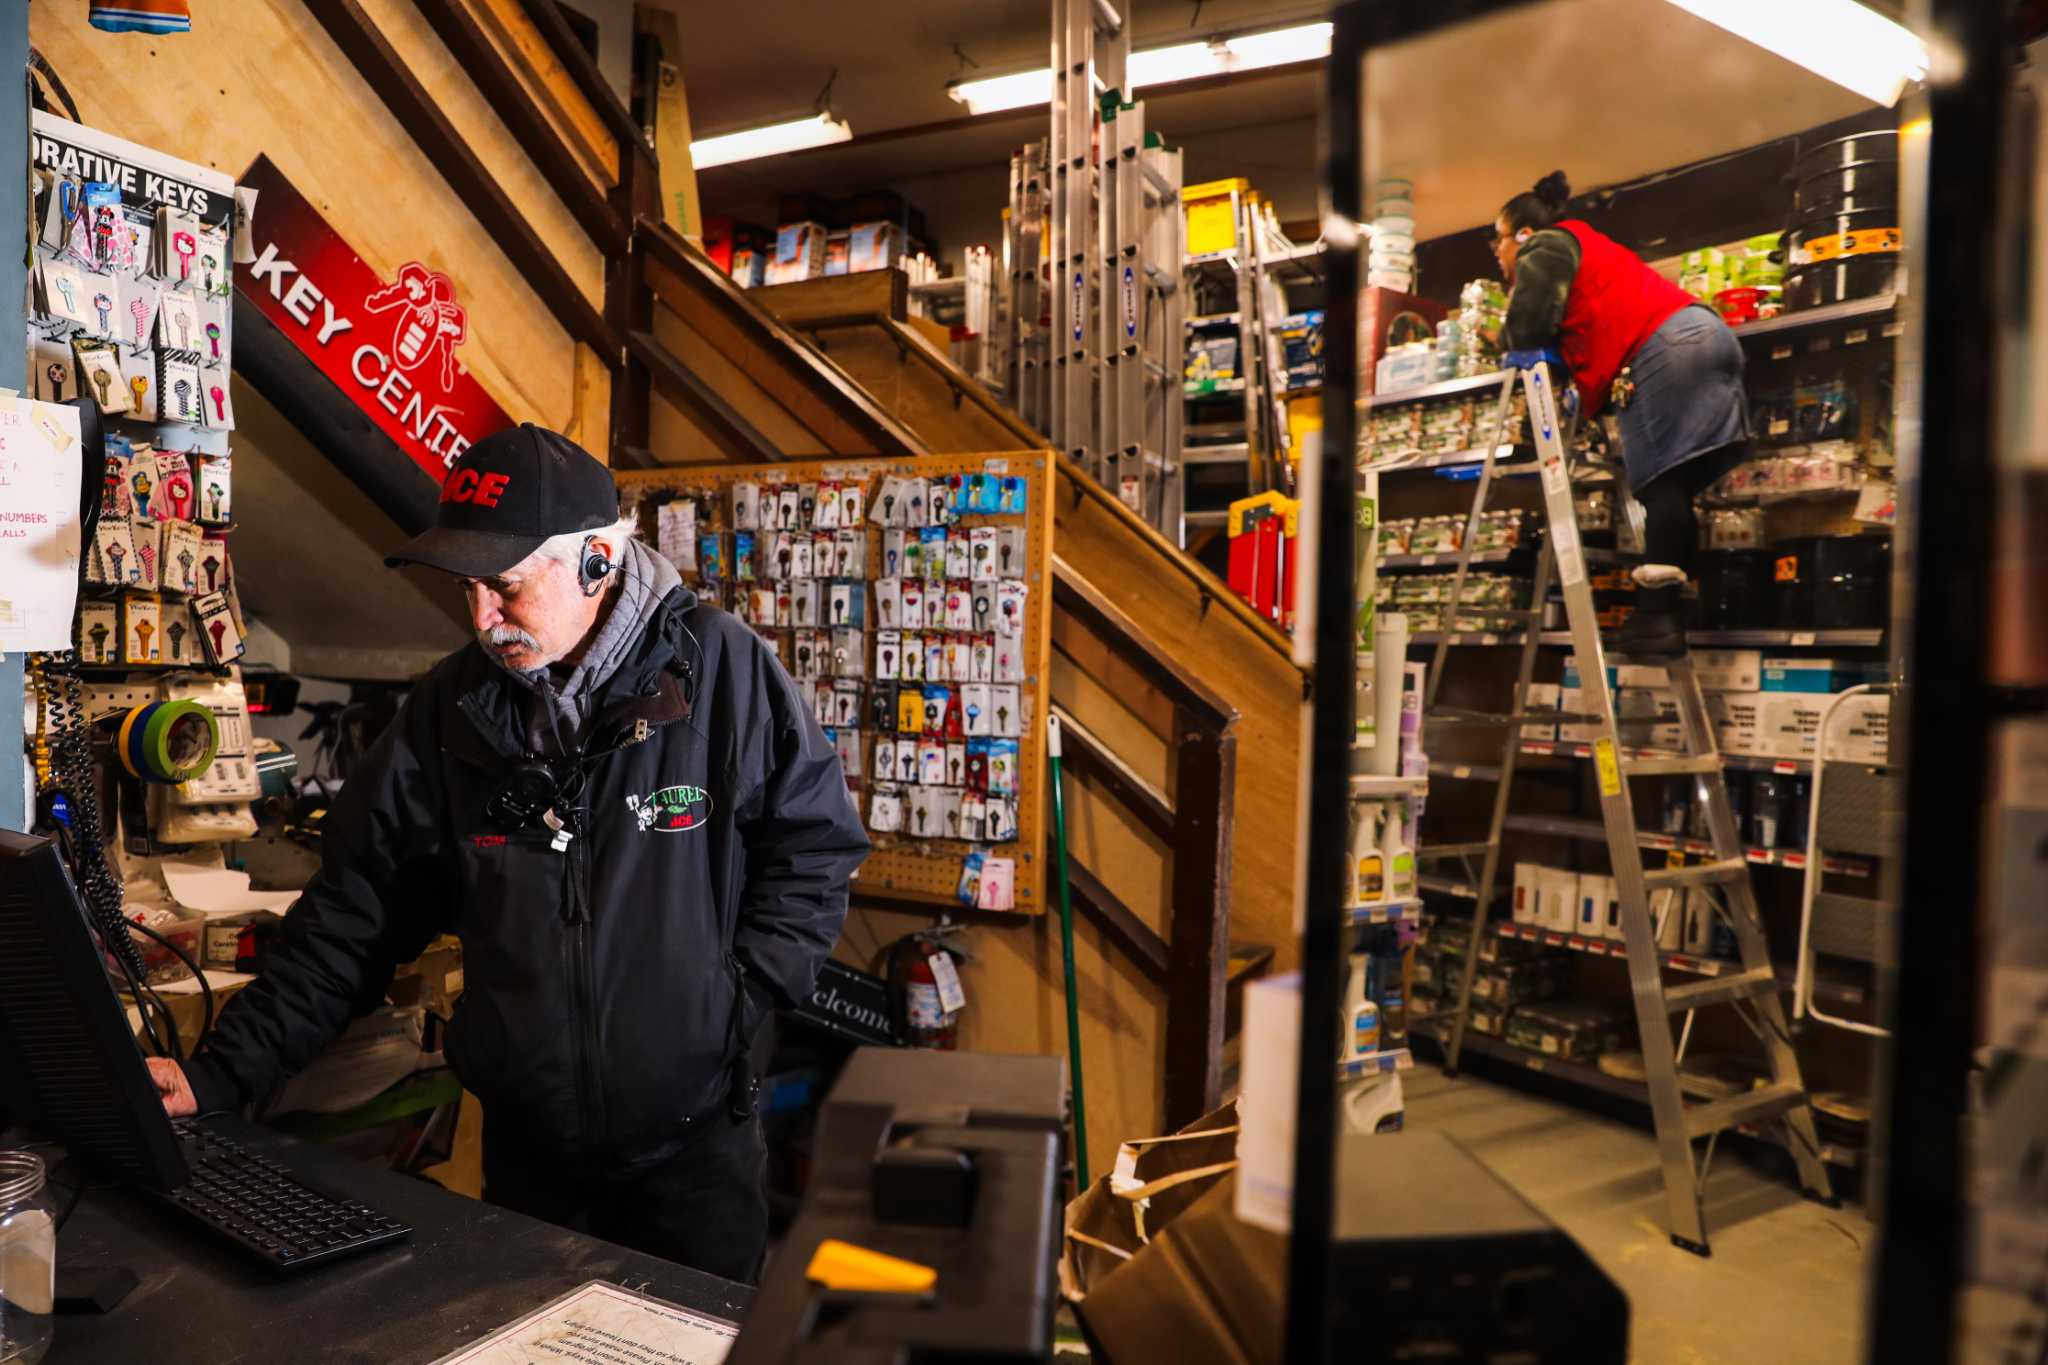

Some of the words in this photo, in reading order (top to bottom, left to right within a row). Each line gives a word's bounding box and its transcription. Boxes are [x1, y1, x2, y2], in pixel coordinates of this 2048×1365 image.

[145, 172, 209, 216] KEYS
[250, 243, 353, 346] KEY
[351, 344, 471, 469] CENTE
[0, 512, 48, 524] NUMBERS
[651, 786, 704, 806] LAUREL
[811, 986, 892, 1034] elcom
[580, 1334, 601, 1345] sure
[616, 1336, 639, 1349] don't
[599, 1341, 624, 1353] make
[637, 1343, 657, 1356] they
[623, 1349, 652, 1365] Please
